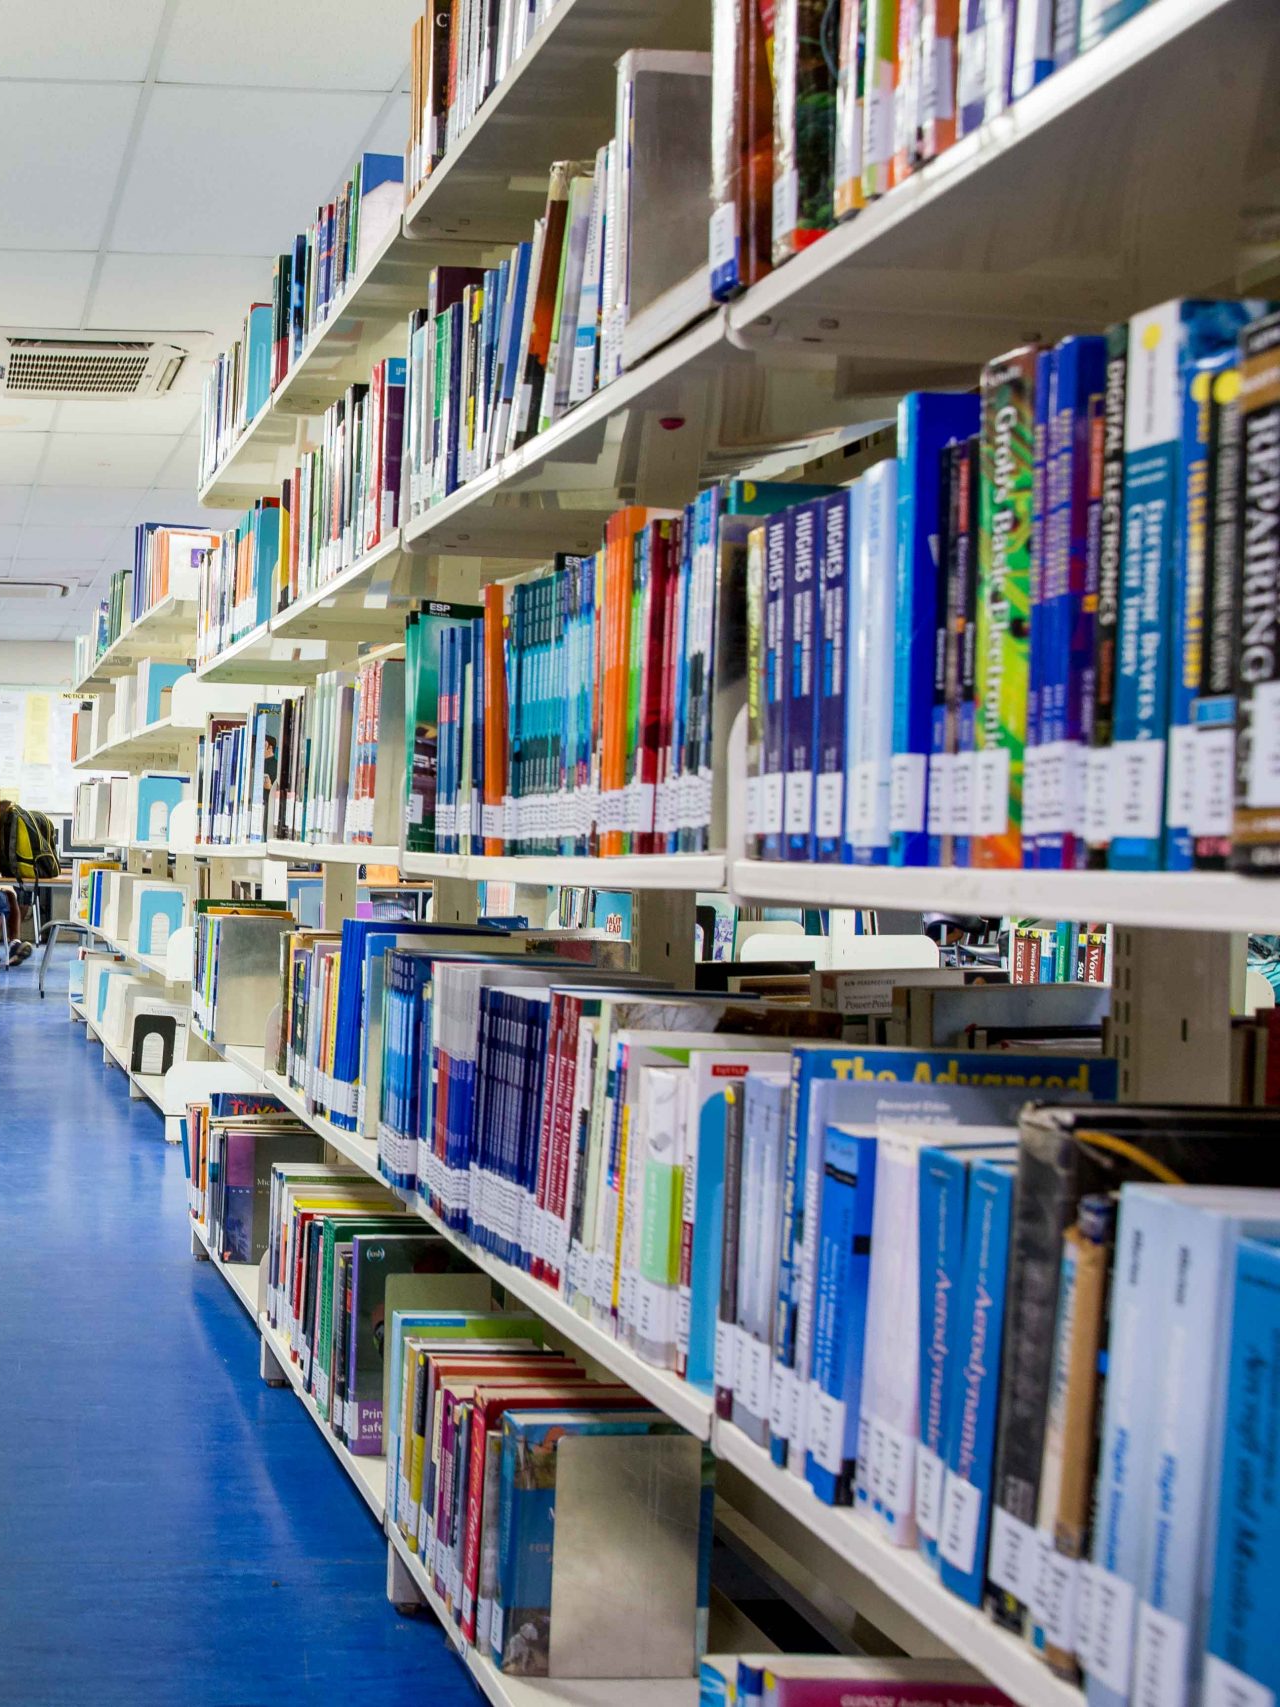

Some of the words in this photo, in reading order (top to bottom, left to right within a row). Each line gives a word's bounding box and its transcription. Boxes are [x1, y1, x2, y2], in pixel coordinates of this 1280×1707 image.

[1106, 361, 1125, 456] DIGITAL
[990, 405, 1019, 504] Grob's
[565, 555, 582, 566] ES
[768, 522, 786, 592] HUGHES
[793, 510, 813, 583] HUGHES
[825, 504, 846, 580] HUGHES
[990, 508, 1015, 593] Basic
[1100, 461, 1122, 626] ELECTRONICS
[1240, 413, 1279, 683] REPAIRING
[430, 602, 451, 612] ESP
[749, 656, 758, 719] KOREA
[984, 600, 1012, 748] Electronic
[606, 925, 621, 934] LEAD
[1016, 941, 1025, 972] Excel
[1077, 961, 1085, 979] SQL
[1088, 948, 1099, 983] Word
[544, 1053, 556, 1101] Reading
[555, 1056, 568, 1104] Reading
[564, 1059, 576, 1107] Reading
[831, 1056, 898, 1081] The
[788, 1081, 801, 1138] Advanced
[257, 1177, 269, 1187] Mic
[537, 1125, 552, 1210] Understanding
[548, 1128, 563, 1214] Understanding
[556, 1132, 571, 1217] Understanding
[683, 1154, 695, 1217] KOREAN
[785, 1138, 798, 1177] Pilot's
[783, 1179, 795, 1214] Flight
[803, 1168, 819, 1261] DYNAMICS
[781, 1215, 793, 1262] Manual
[798, 1283, 814, 1347] FLIGHT
[956, 1284, 993, 1482] Aerodynamics
[362, 1408, 383, 1420] Prin
[362, 1421, 383, 1433] safe
[1111, 1426, 1130, 1486] Flight
[1155, 1453, 1178, 1513] Flight
